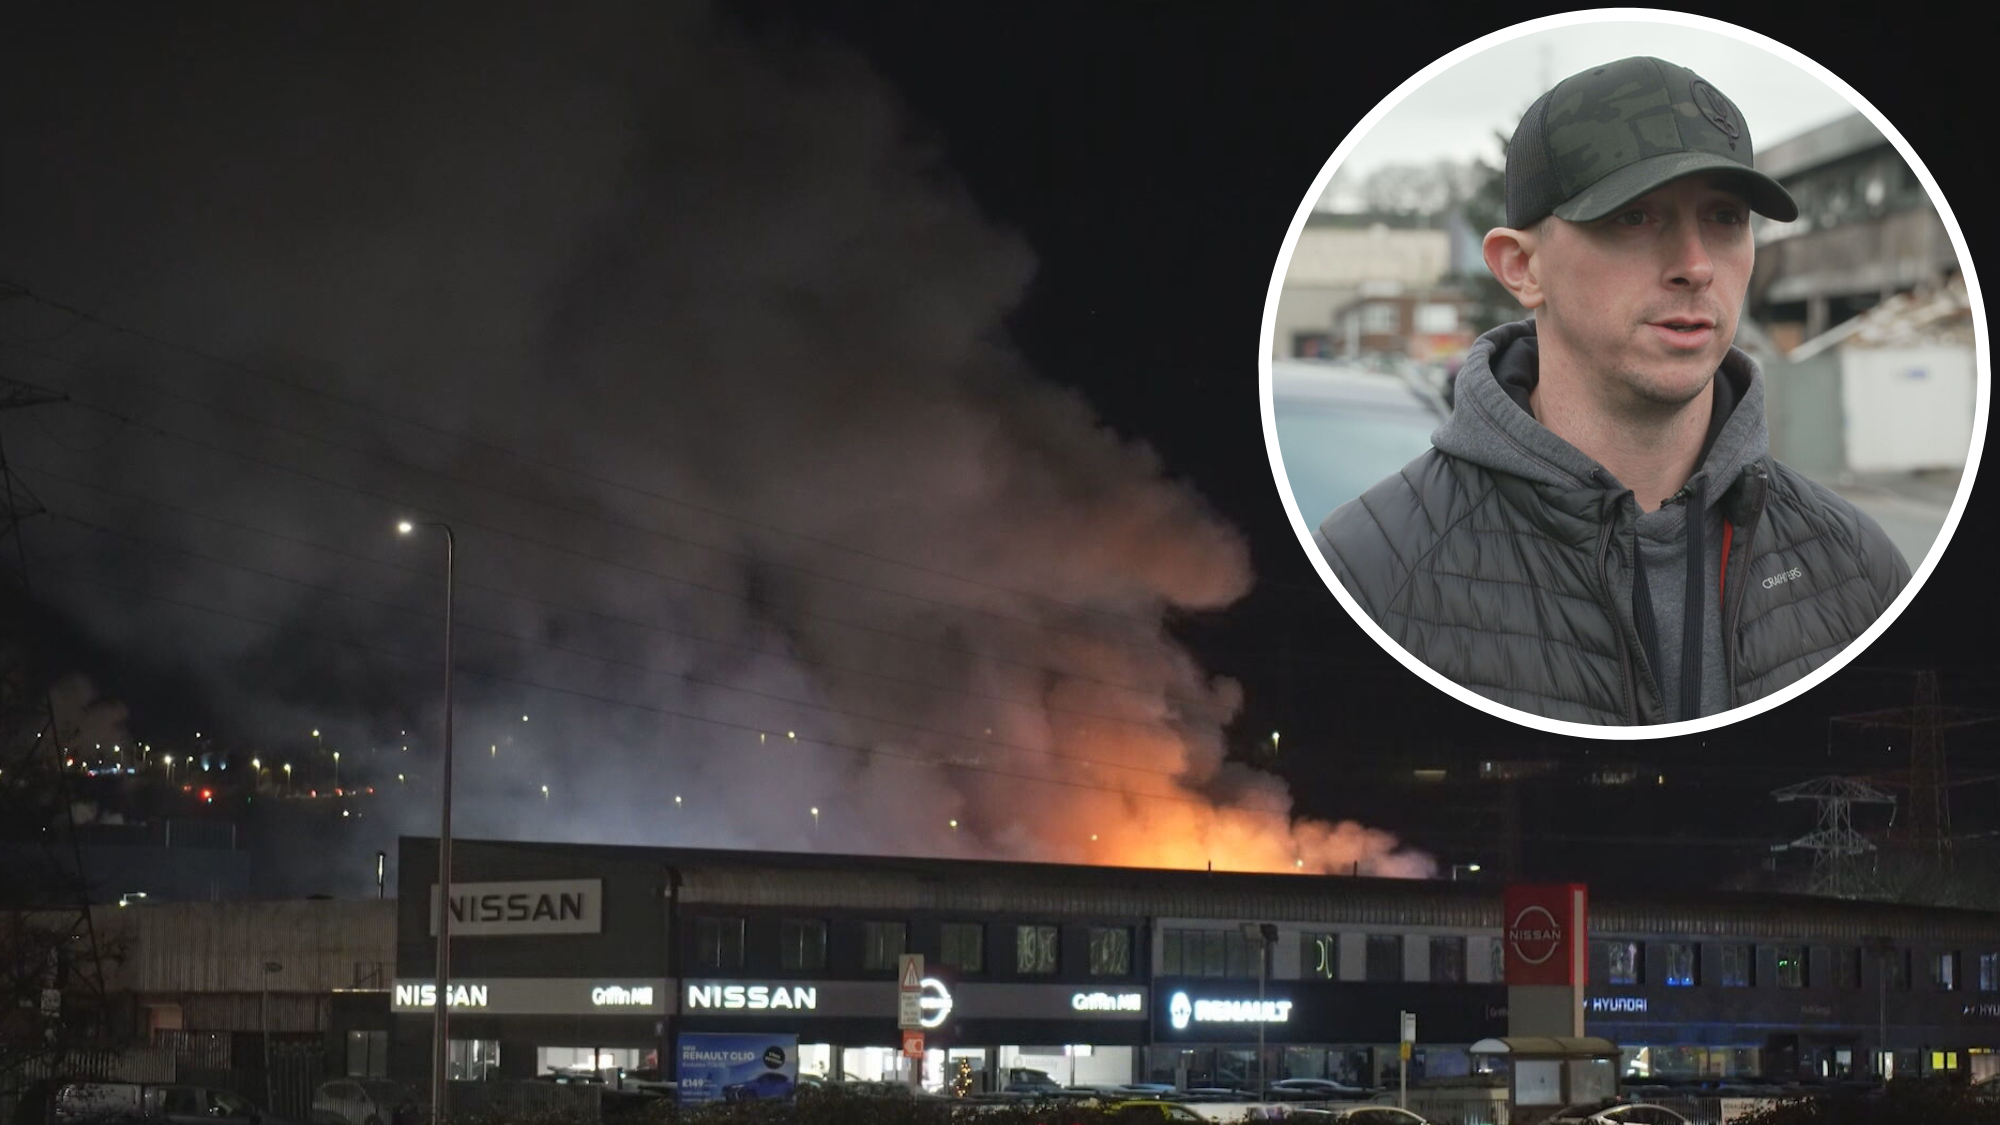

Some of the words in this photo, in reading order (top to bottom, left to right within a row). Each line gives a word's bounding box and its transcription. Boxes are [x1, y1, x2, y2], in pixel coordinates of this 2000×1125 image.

[450, 892, 583, 922] NISSAN
[1509, 929, 1561, 941] NISSAN
[592, 985, 630, 1006] Griffin
[688, 985, 816, 1010] NISSAN
[1593, 997, 1648, 1013] HYUNDAI
[1194, 999, 1293, 1022] RENAULT
[682, 1051, 729, 1061] RENAULT
